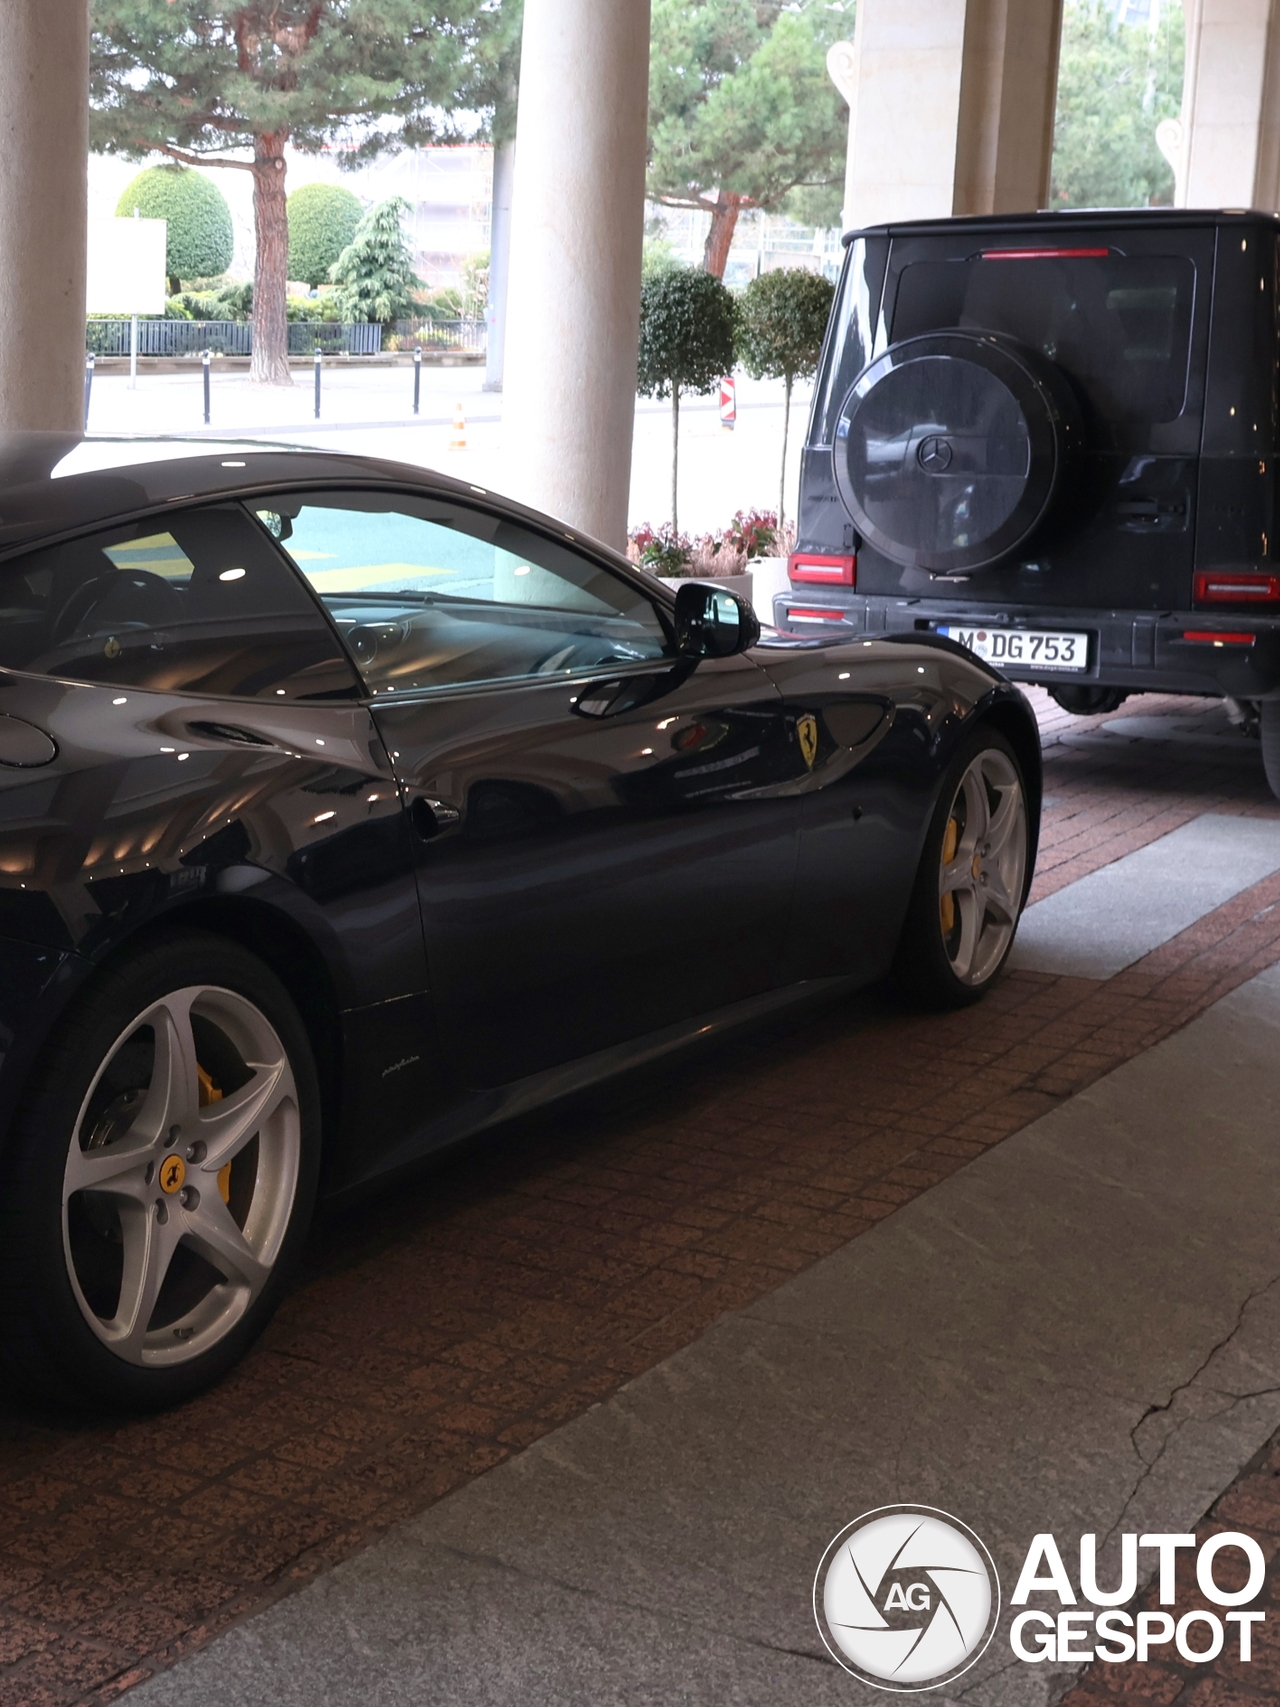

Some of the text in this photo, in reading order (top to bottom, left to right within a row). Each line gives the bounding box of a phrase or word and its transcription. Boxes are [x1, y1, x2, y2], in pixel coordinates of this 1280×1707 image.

[958, 631, 1076, 662] M DG 753
